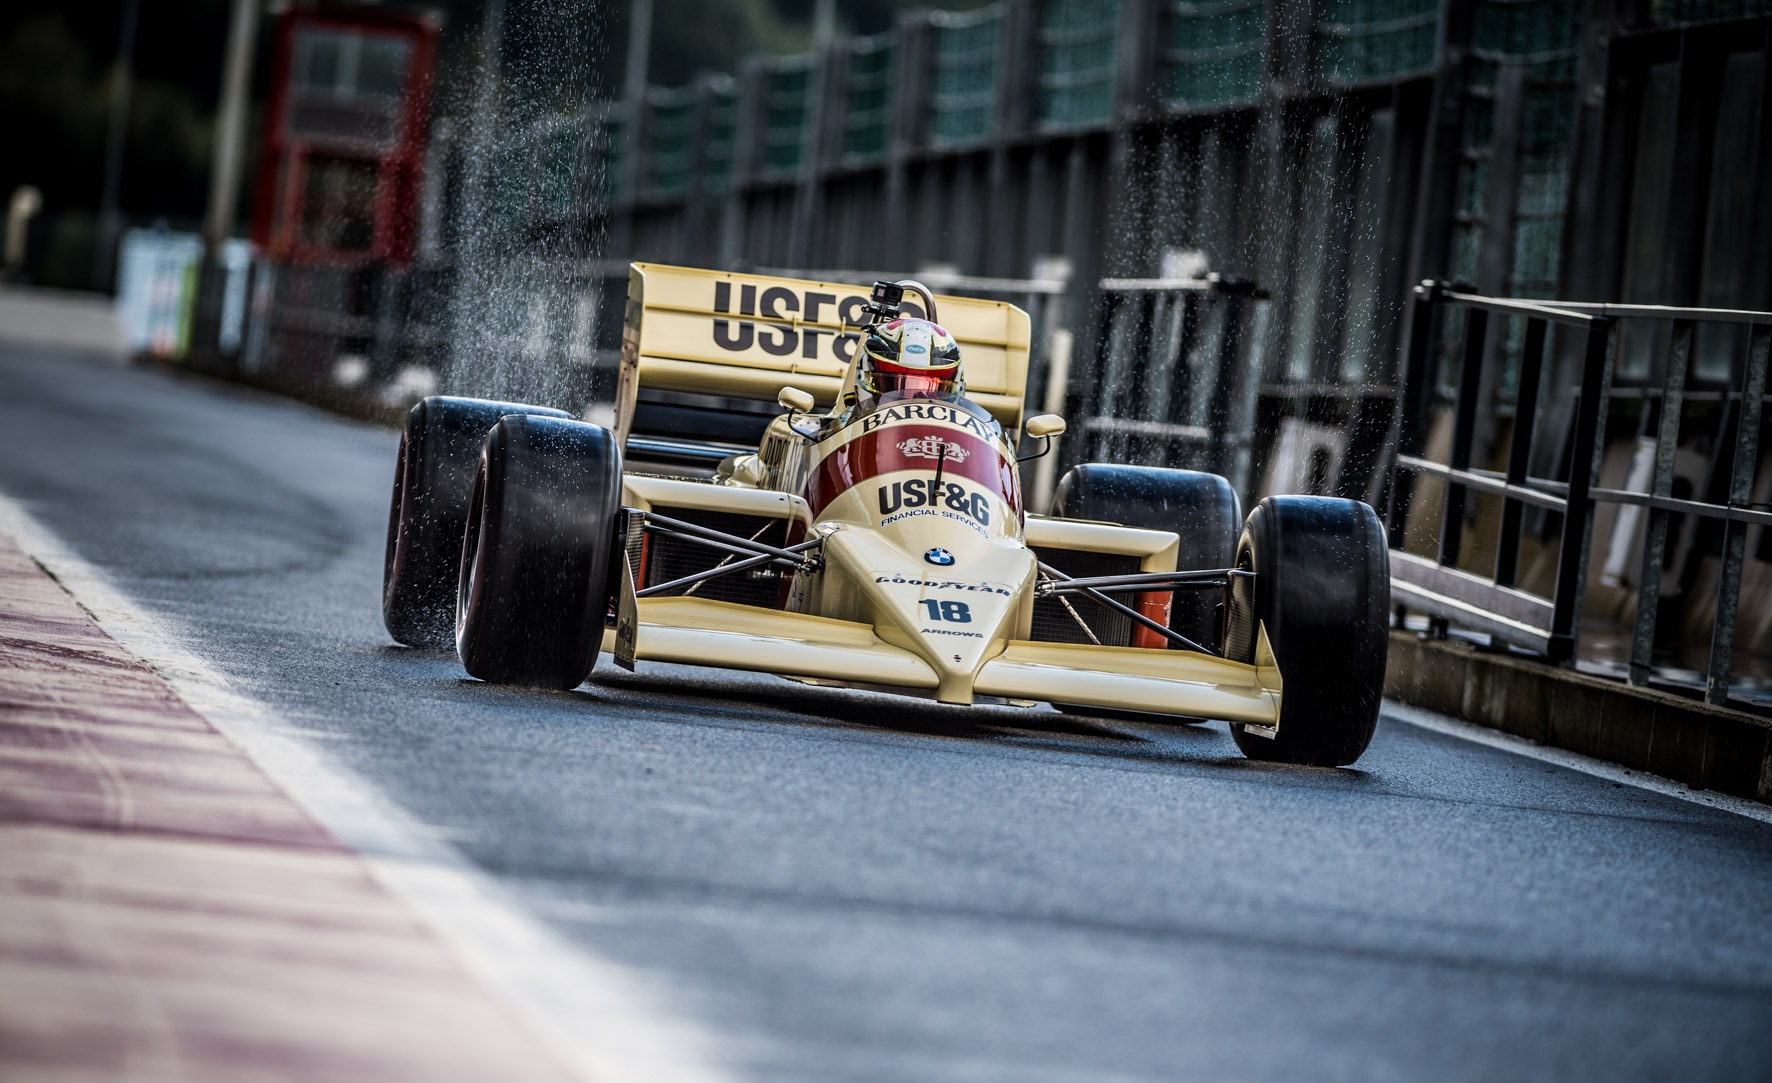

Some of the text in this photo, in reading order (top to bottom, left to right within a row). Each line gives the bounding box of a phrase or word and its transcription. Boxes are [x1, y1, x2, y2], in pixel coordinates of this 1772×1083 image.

[713, 281, 926, 364] USF&
[861, 404, 994, 443] BARCLAY
[878, 479, 990, 527] USF&G
[881, 509, 989, 539] FINANCIAL SERVICES
[875, 575, 1011, 597] GOODYEAR
[918, 598, 972, 623] 18
[921, 628, 984, 638] ARROWS
